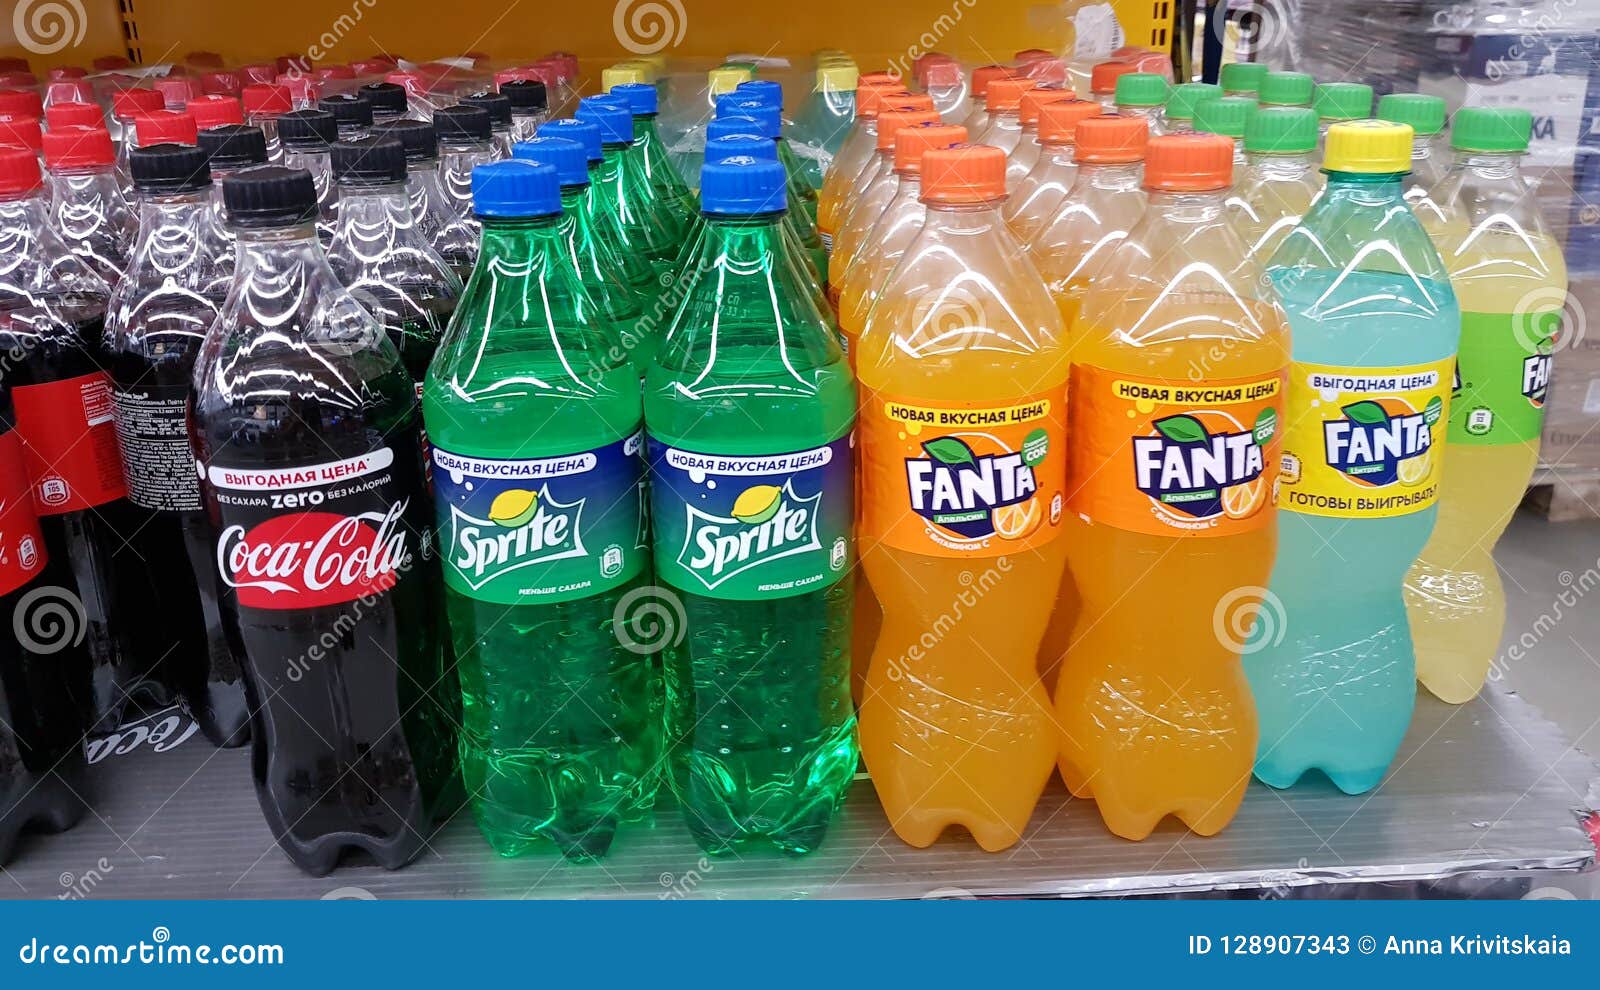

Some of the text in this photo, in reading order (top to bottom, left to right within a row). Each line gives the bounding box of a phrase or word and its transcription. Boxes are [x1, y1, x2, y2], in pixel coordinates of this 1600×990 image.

[1314, 376, 1396, 391] ВЫГОДНАЯ
[1120, 384, 1169, 401] НОВАЯ
[1175, 389, 1241, 403] ВКУСНАЯ
[891, 406, 935, 423] НОВАЯ
[940, 411, 1006, 425] ВКУСНАЯ
[1325, 414, 1431, 464] FANTA
[437, 455, 470, 471] НОВАЯ
[473, 464, 541, 476] ВКУСНАЯ
[672, 454, 714, 471] НОВАЯ
[717, 459, 787, 472] ВКУСНАЯ
[1135, 433, 1263, 490] FANTA
[225, 471, 316, 487] ВЫГОДНАЯ
[327, 474, 392, 500] БЕЗ КАЛОРИЙ
[907, 454, 1036, 511] FANTA
[217, 494, 268, 507] БЕЗ САХАРА
[271, 490, 324, 509] zero
[1290, 491, 1352, 510] ГОТОВЫ
[217, 495, 410, 594] Coca-Cola
[457, 504, 569, 577] Sprite
[690, 499, 808, 577] Sprite
[518, 580, 591, 596] МЕНЬШЕ САХАРА
[758, 580, 794, 591] МЕНЬШЕ
